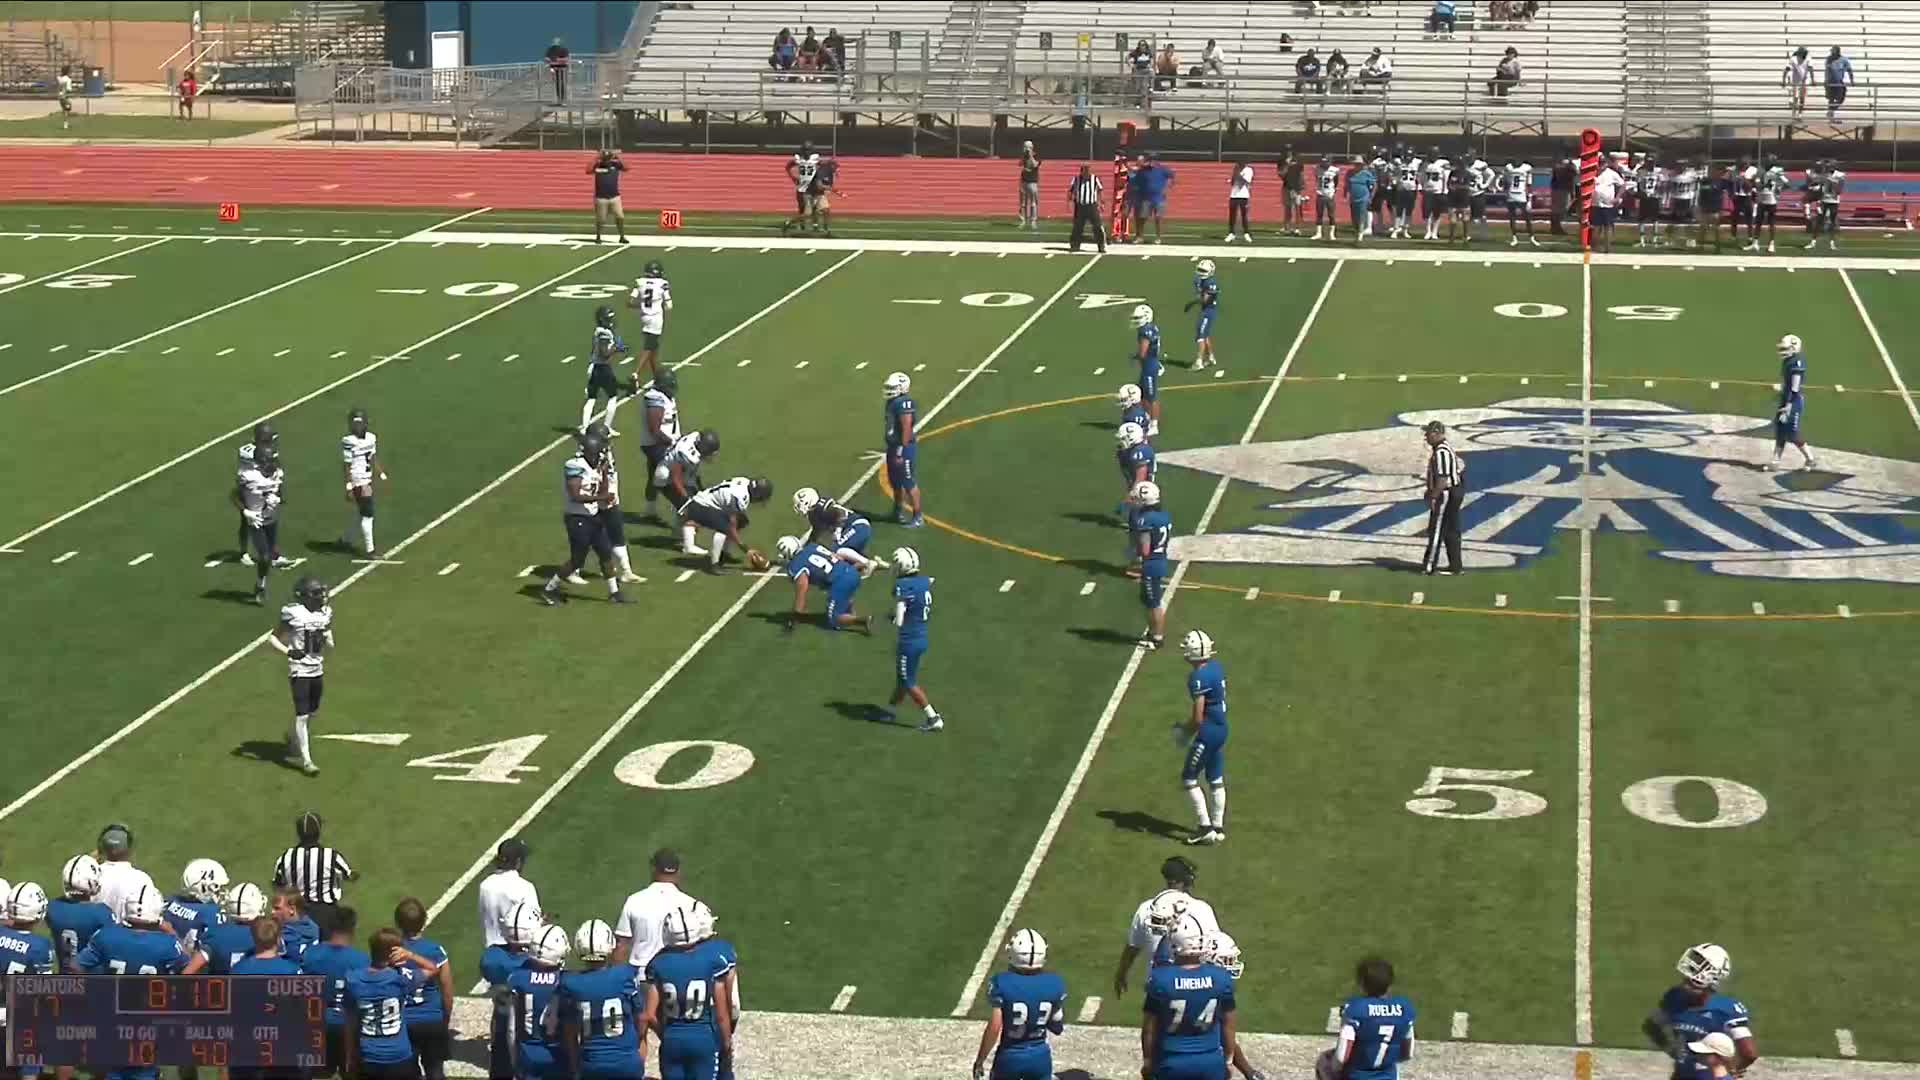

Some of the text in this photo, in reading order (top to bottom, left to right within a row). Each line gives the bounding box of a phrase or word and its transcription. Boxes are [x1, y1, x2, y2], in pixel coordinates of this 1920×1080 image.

[221, 204, 236, 219] 20
[661, 211, 678, 228] 30
[406, 733, 755, 790] 40
[1406, 766, 1768, 828] 50
[1174, 976, 1213, 991] LINEHAN
[1368, 1003, 1403, 1018] RUELAS
[1373, 1025, 1396, 1068] 7
